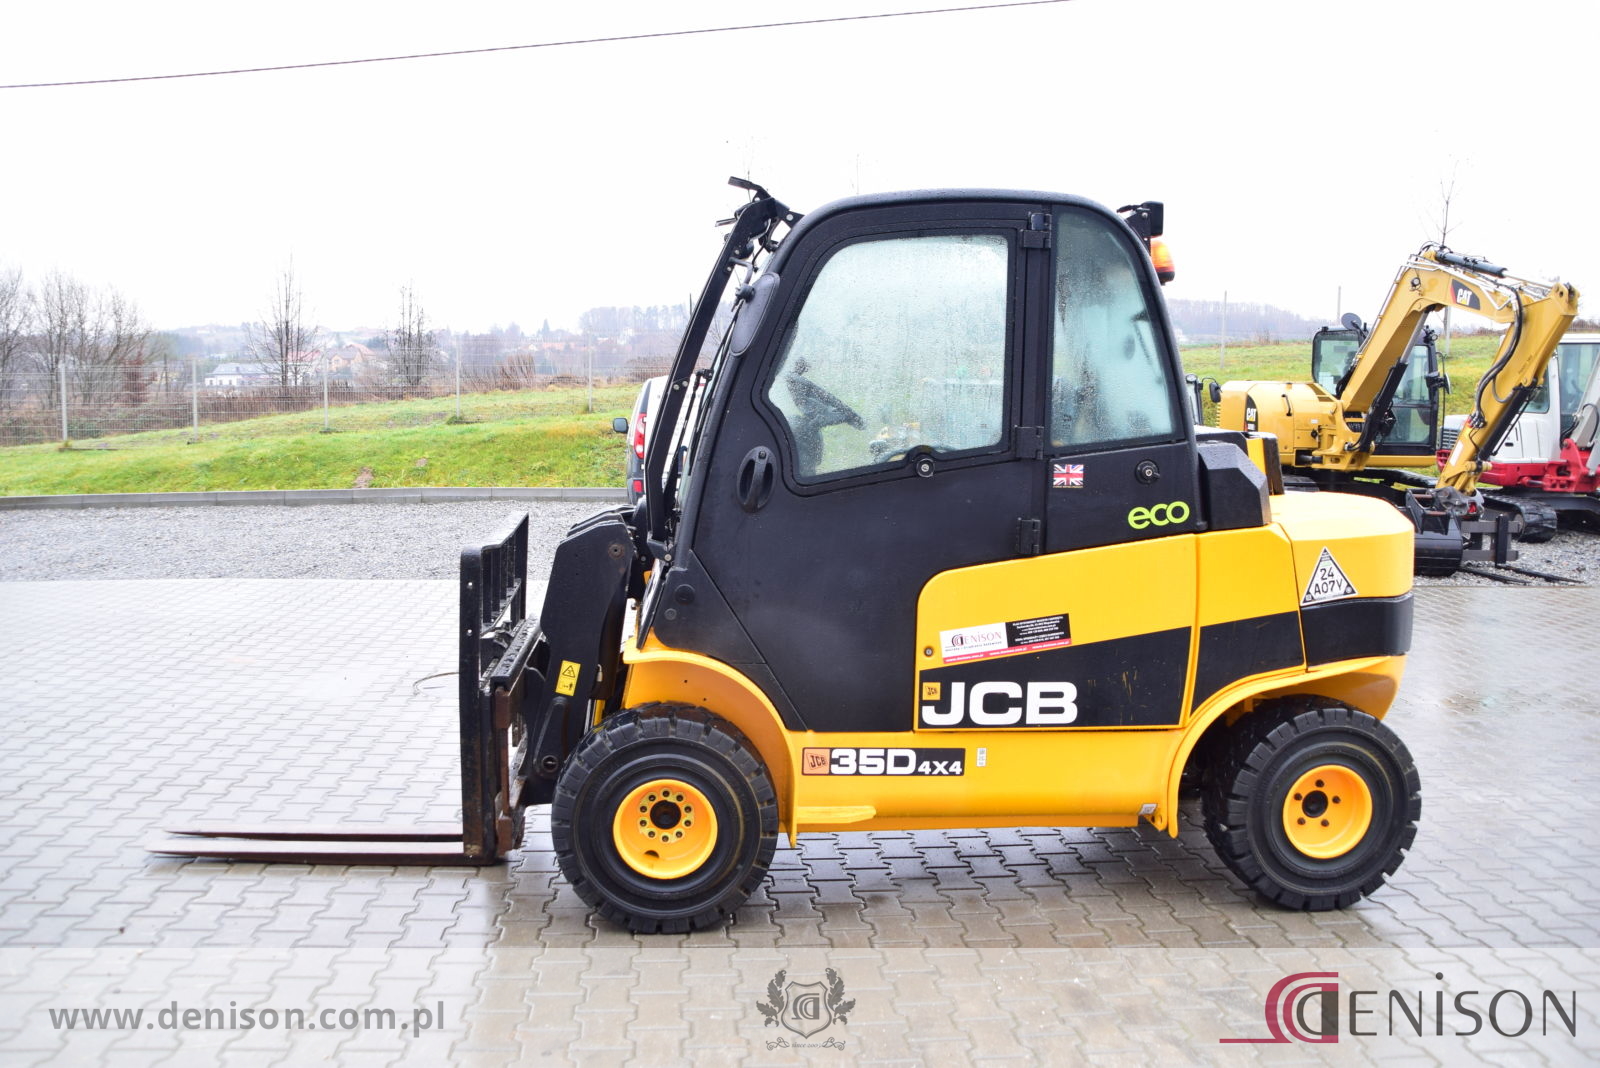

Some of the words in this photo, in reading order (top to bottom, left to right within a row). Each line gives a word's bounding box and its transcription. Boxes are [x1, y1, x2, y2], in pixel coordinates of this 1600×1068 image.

[1456, 288, 1472, 305] CAT
[1246, 408, 1257, 421] CAT
[1128, 501, 1190, 529] eco
[1320, 566, 1334, 580] 24
[922, 681, 1078, 725] JCB
[809, 754, 827, 768] JCB
[830, 748, 917, 775] 35D
